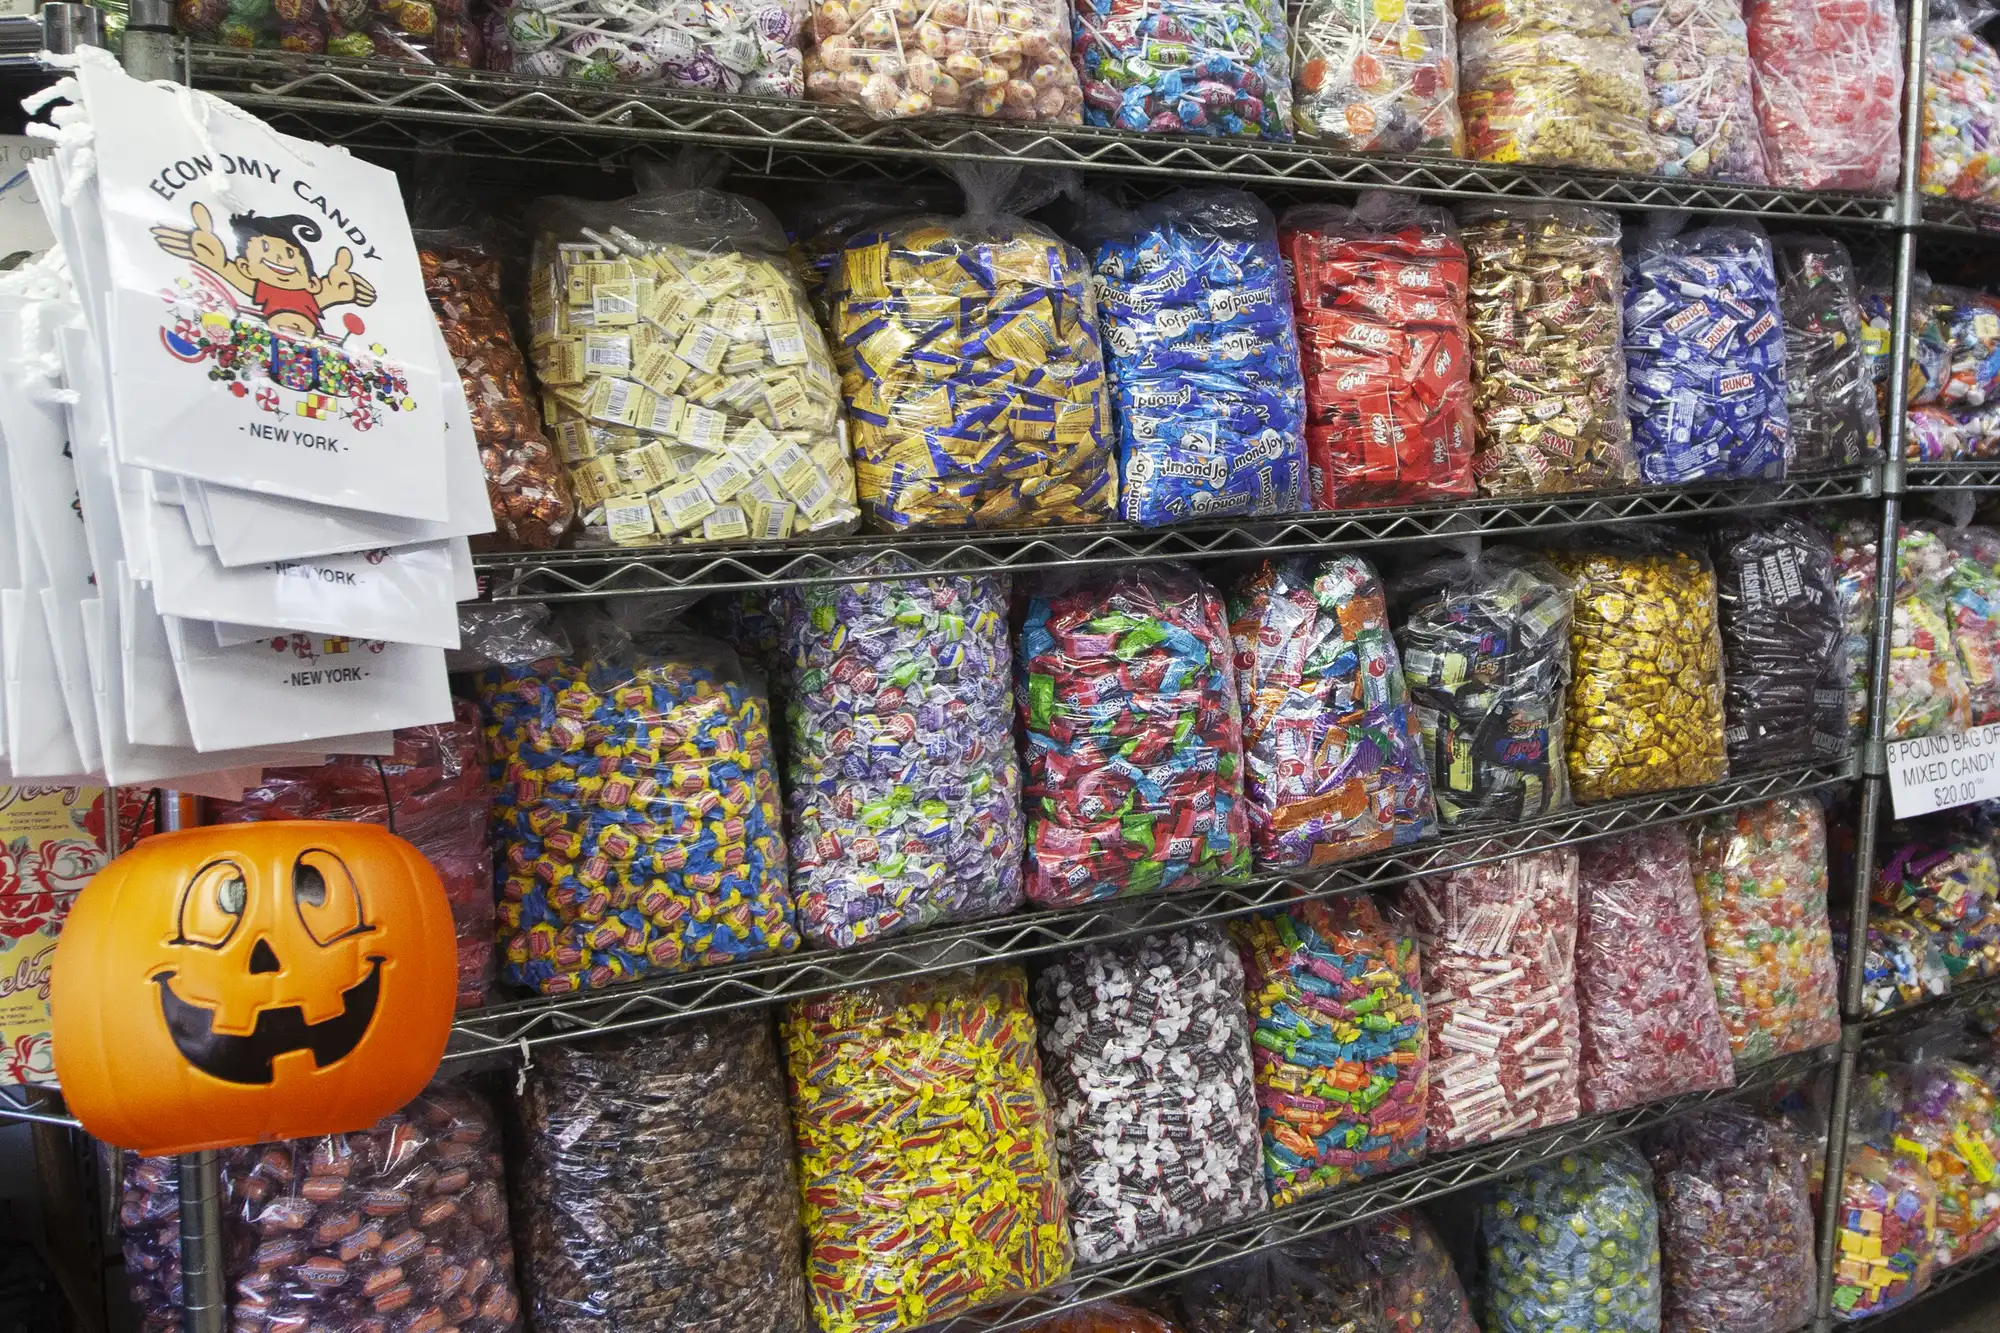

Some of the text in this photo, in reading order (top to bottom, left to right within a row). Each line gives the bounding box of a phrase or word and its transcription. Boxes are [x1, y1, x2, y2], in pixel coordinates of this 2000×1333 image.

[293, 180, 382, 261] CANDY
[1551, 292, 1580, 325] Twix
[1350, 325, 1387, 343] KitKat
[1581, 318, 1606, 344] Twix
[1506, 386, 1541, 405] Twix
[250, 422, 338, 453] NEW YORK
[1371, 414, 1388, 446] KitKat
[1540, 432, 1574, 458] Twix
[1472, 443, 1509, 478] Twix
[316, 568, 356, 586] YORK
[291, 667, 362, 687] NEW YORK
[1888, 725, 2000, 764] 8 POUND BAG OF
[1903, 751, 1996, 787] MIXED CANDY
[1934, 781, 1976, 807] $20.00
[1170, 839, 1192, 850] JOLLY
[1067, 867, 1091, 885] JOLLY
